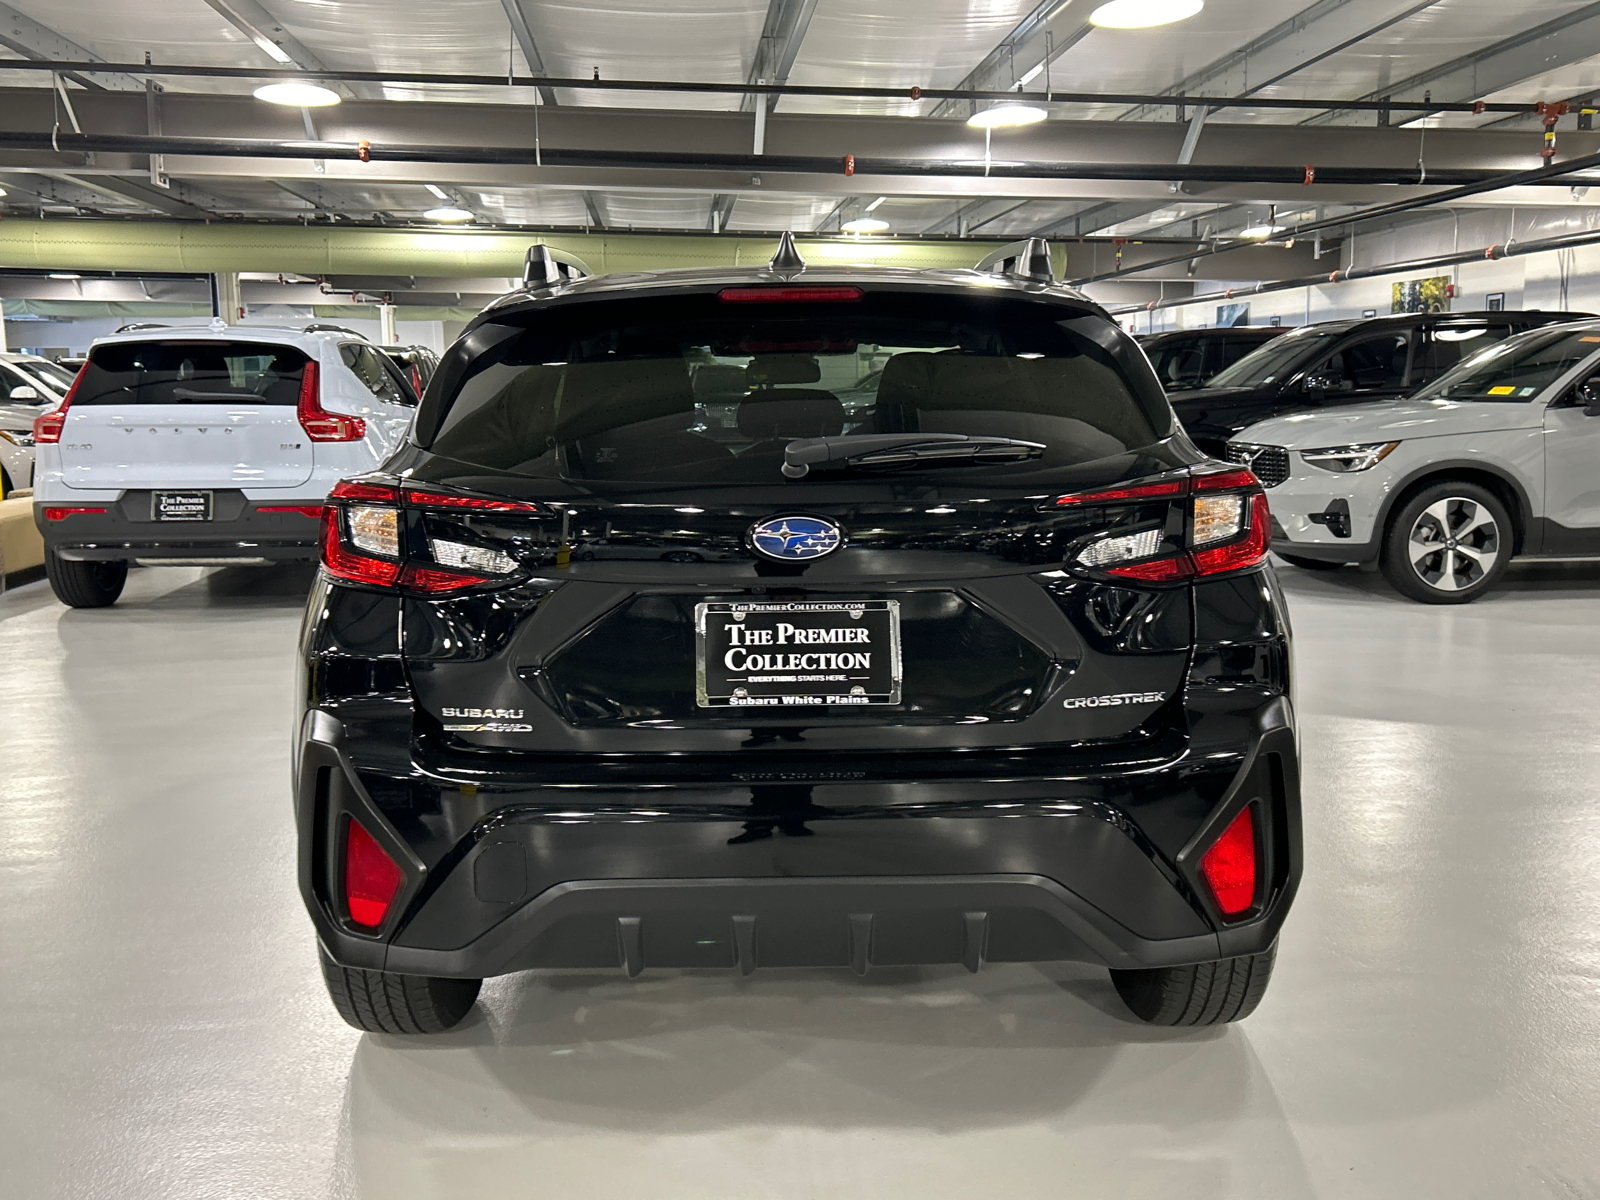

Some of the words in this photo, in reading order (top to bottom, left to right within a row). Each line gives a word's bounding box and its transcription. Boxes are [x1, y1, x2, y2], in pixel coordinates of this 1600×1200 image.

[724, 623, 773, 646] THE
[776, 622, 871, 645] PREMIER
[724, 647, 871, 671] COLLECTION
[747, 675, 797, 683] EVERYTHING
[797, 674, 825, 682] STARTS
[729, 695, 779, 706] Subaru
[781, 695, 823, 705] White
[826, 695, 869, 704] Plains
[1063, 691, 1166, 709] CROSSTREK
[442, 707, 524, 719] SUBARU
